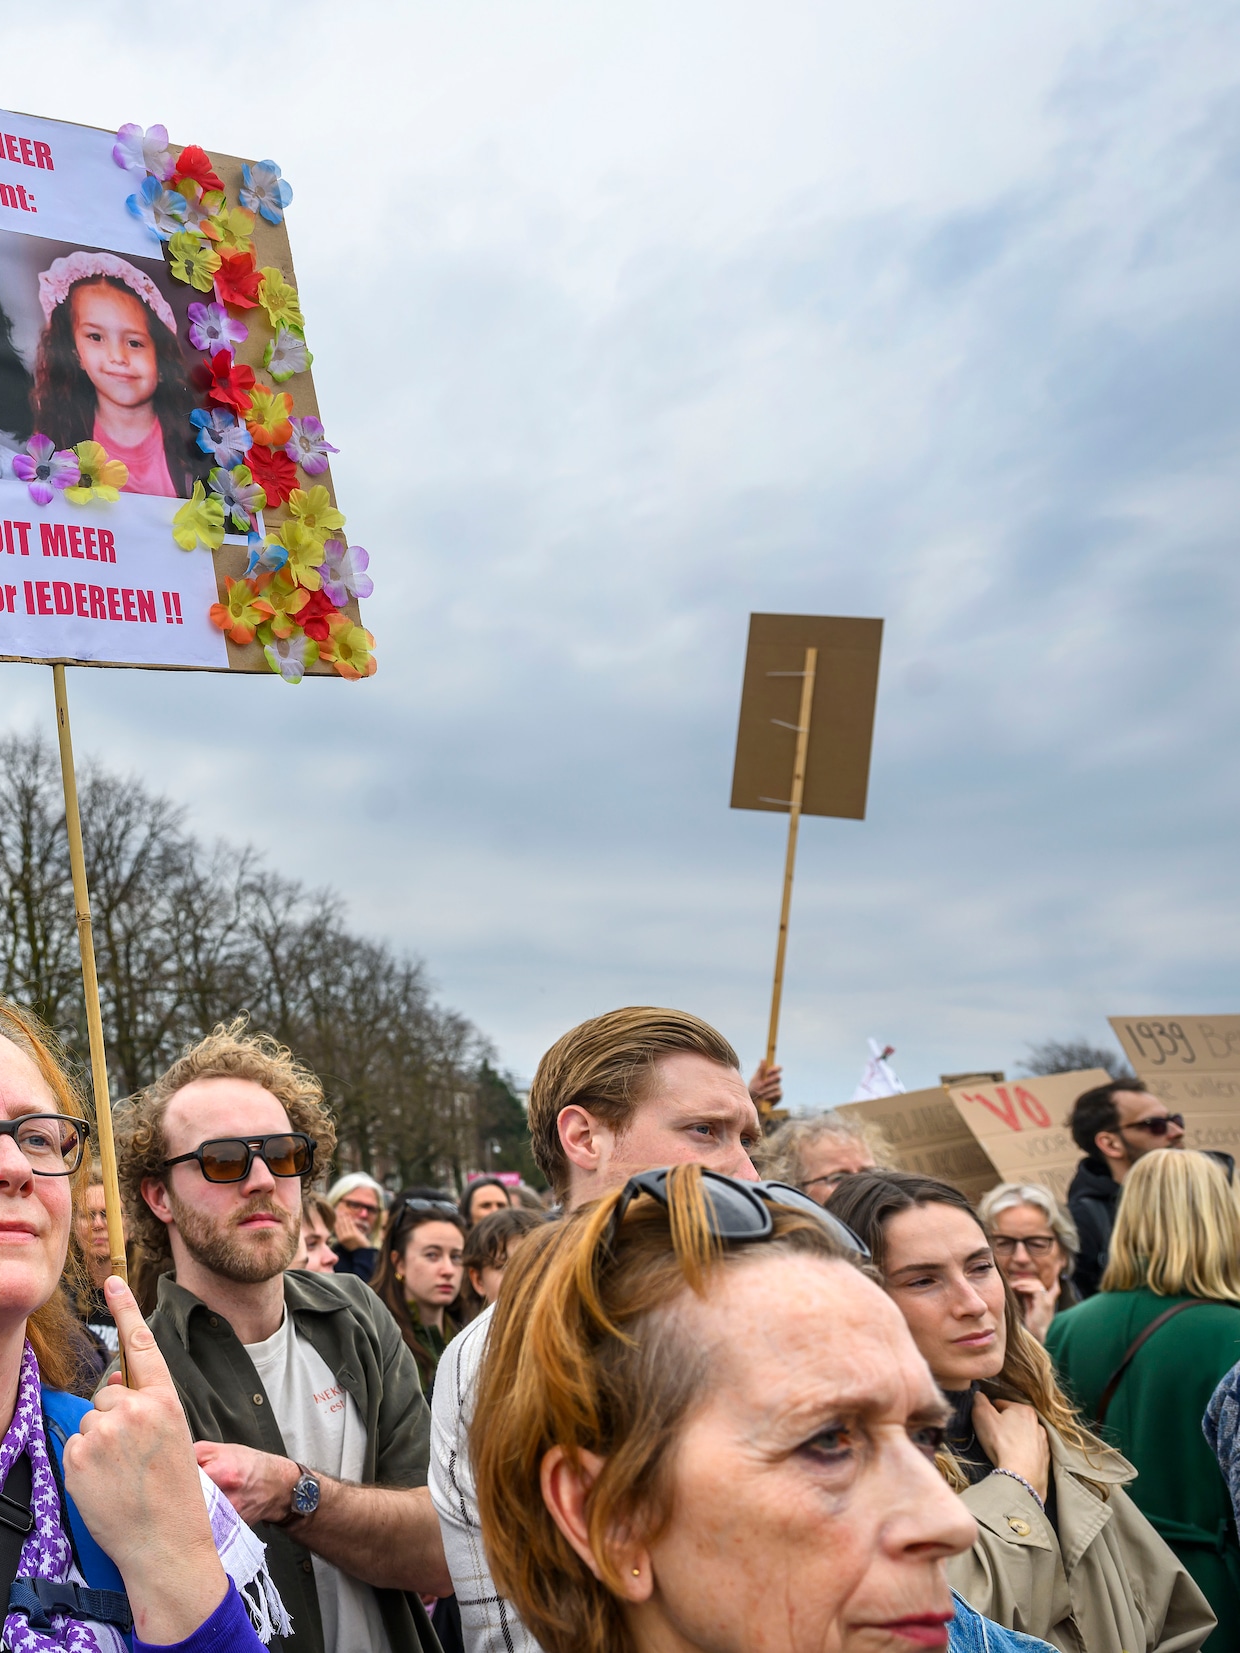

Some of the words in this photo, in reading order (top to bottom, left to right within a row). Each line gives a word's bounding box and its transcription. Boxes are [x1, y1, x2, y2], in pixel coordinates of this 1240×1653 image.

[39, 522, 117, 564] MEER
[23, 580, 158, 623] IEDEREEN
[1124, 1021, 1197, 1065] 1939
